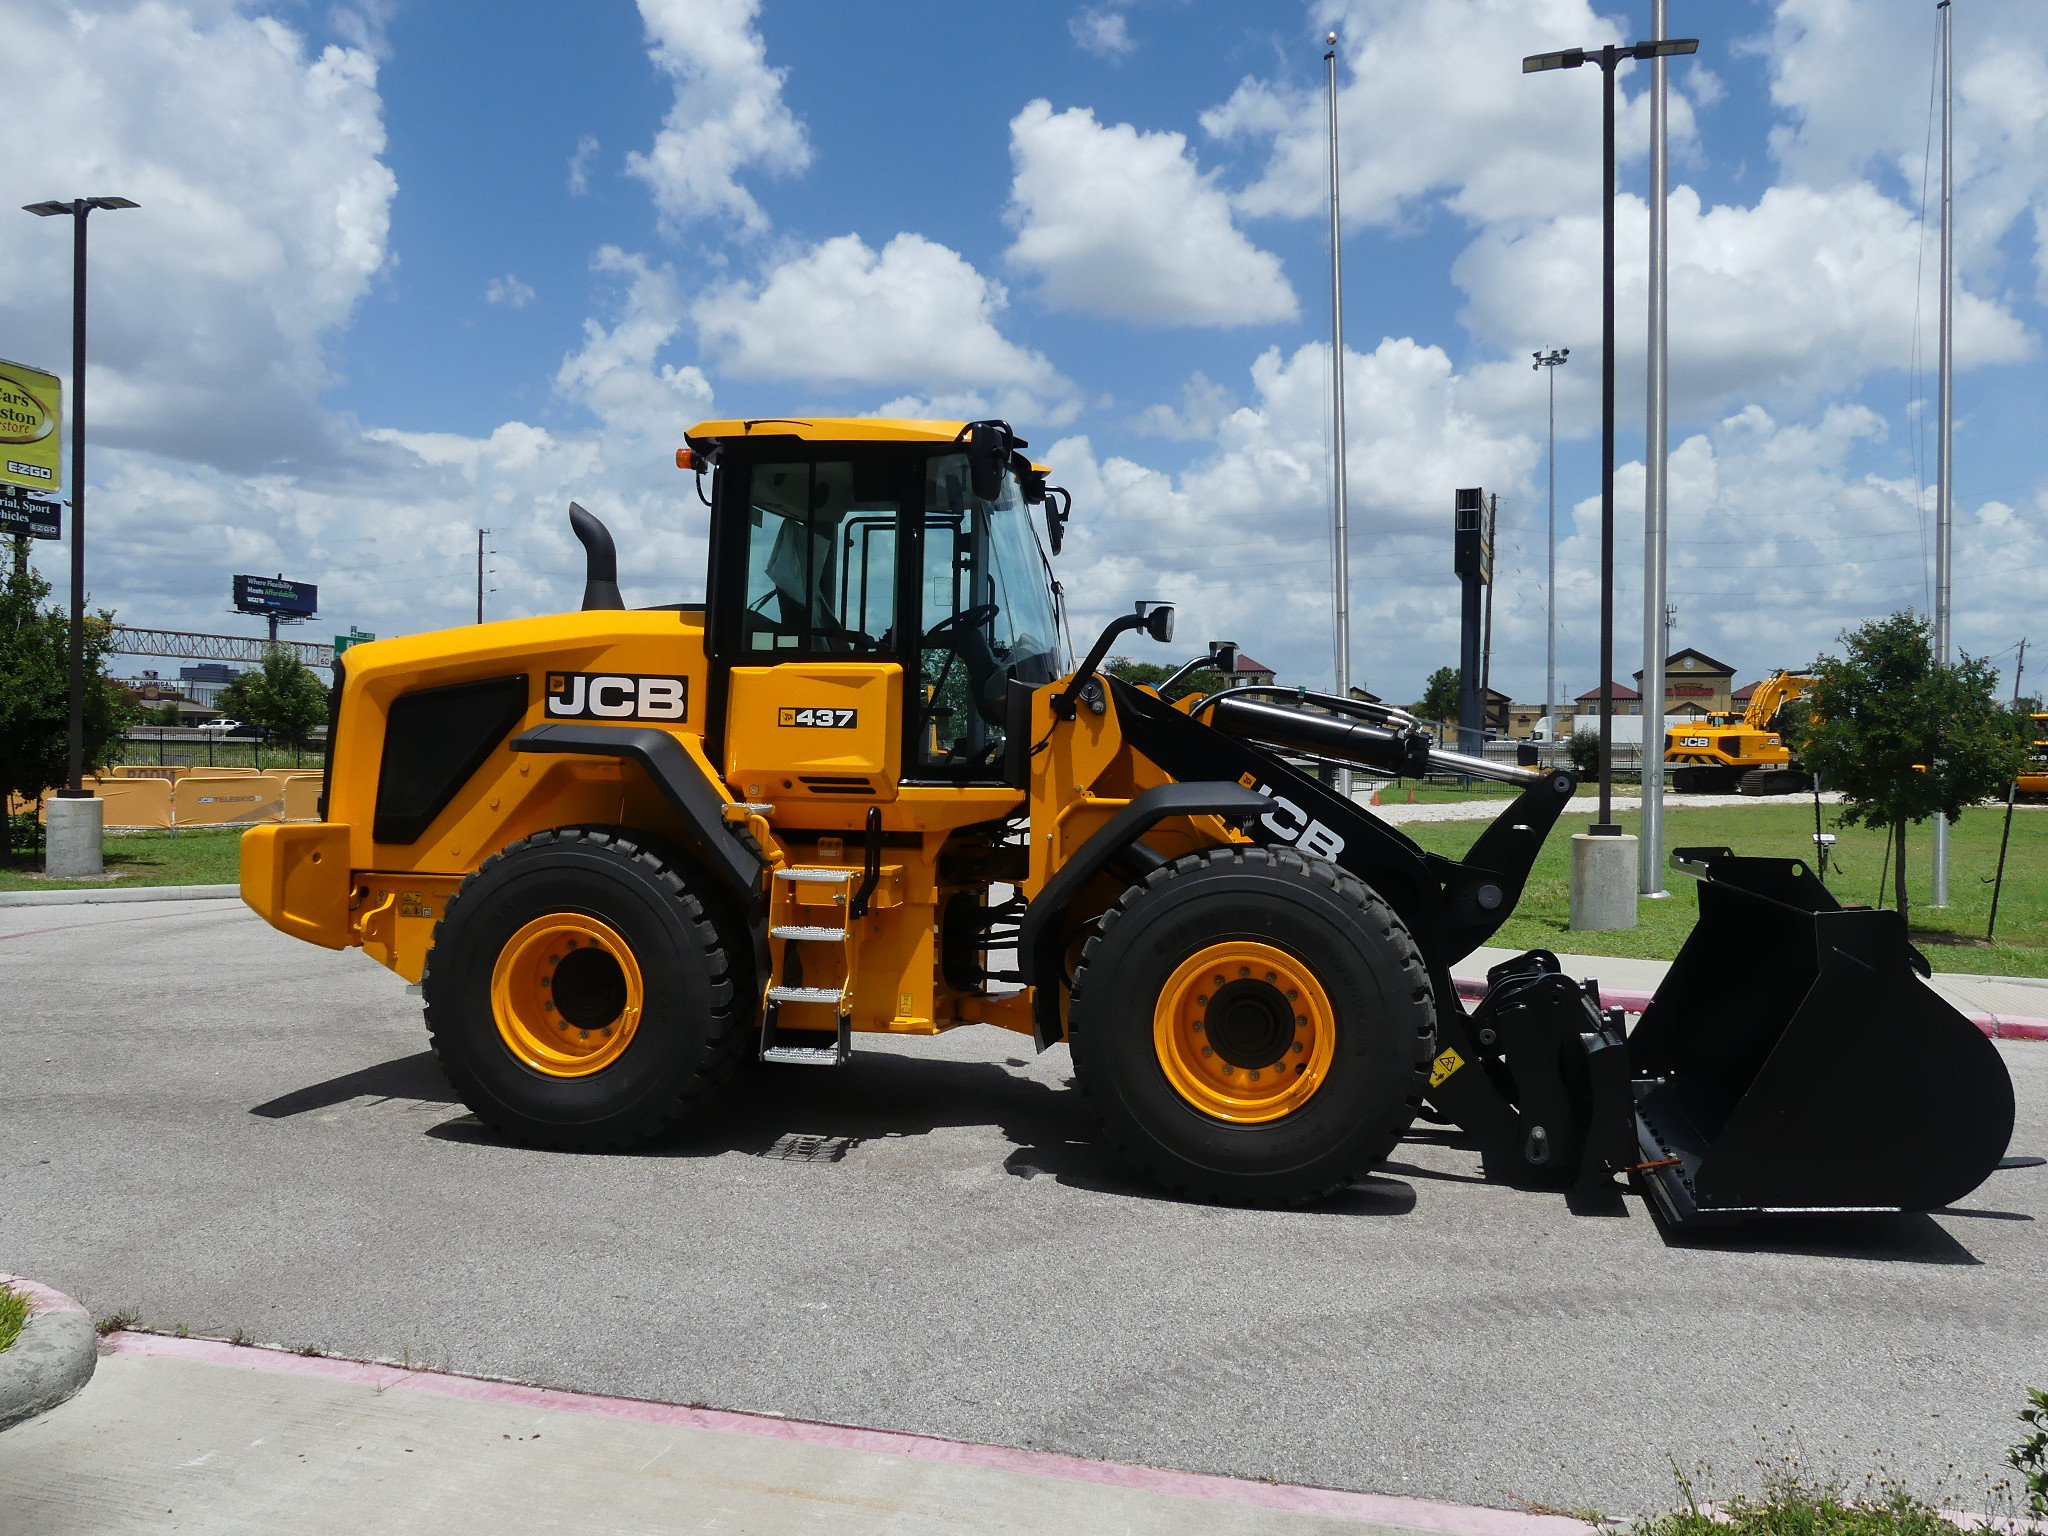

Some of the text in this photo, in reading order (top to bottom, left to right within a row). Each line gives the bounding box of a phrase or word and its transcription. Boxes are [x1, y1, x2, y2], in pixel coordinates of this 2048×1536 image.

[22, 500, 50, 514] Sport
[0, 509, 30, 523] hicles
[247, 578, 293, 591] Where Flexibility
[247, 586, 298, 600] Meets Affordability
[549, 676, 684, 718] JCB
[797, 709, 853, 727] 437
[1680, 737, 1708, 747] JCB
